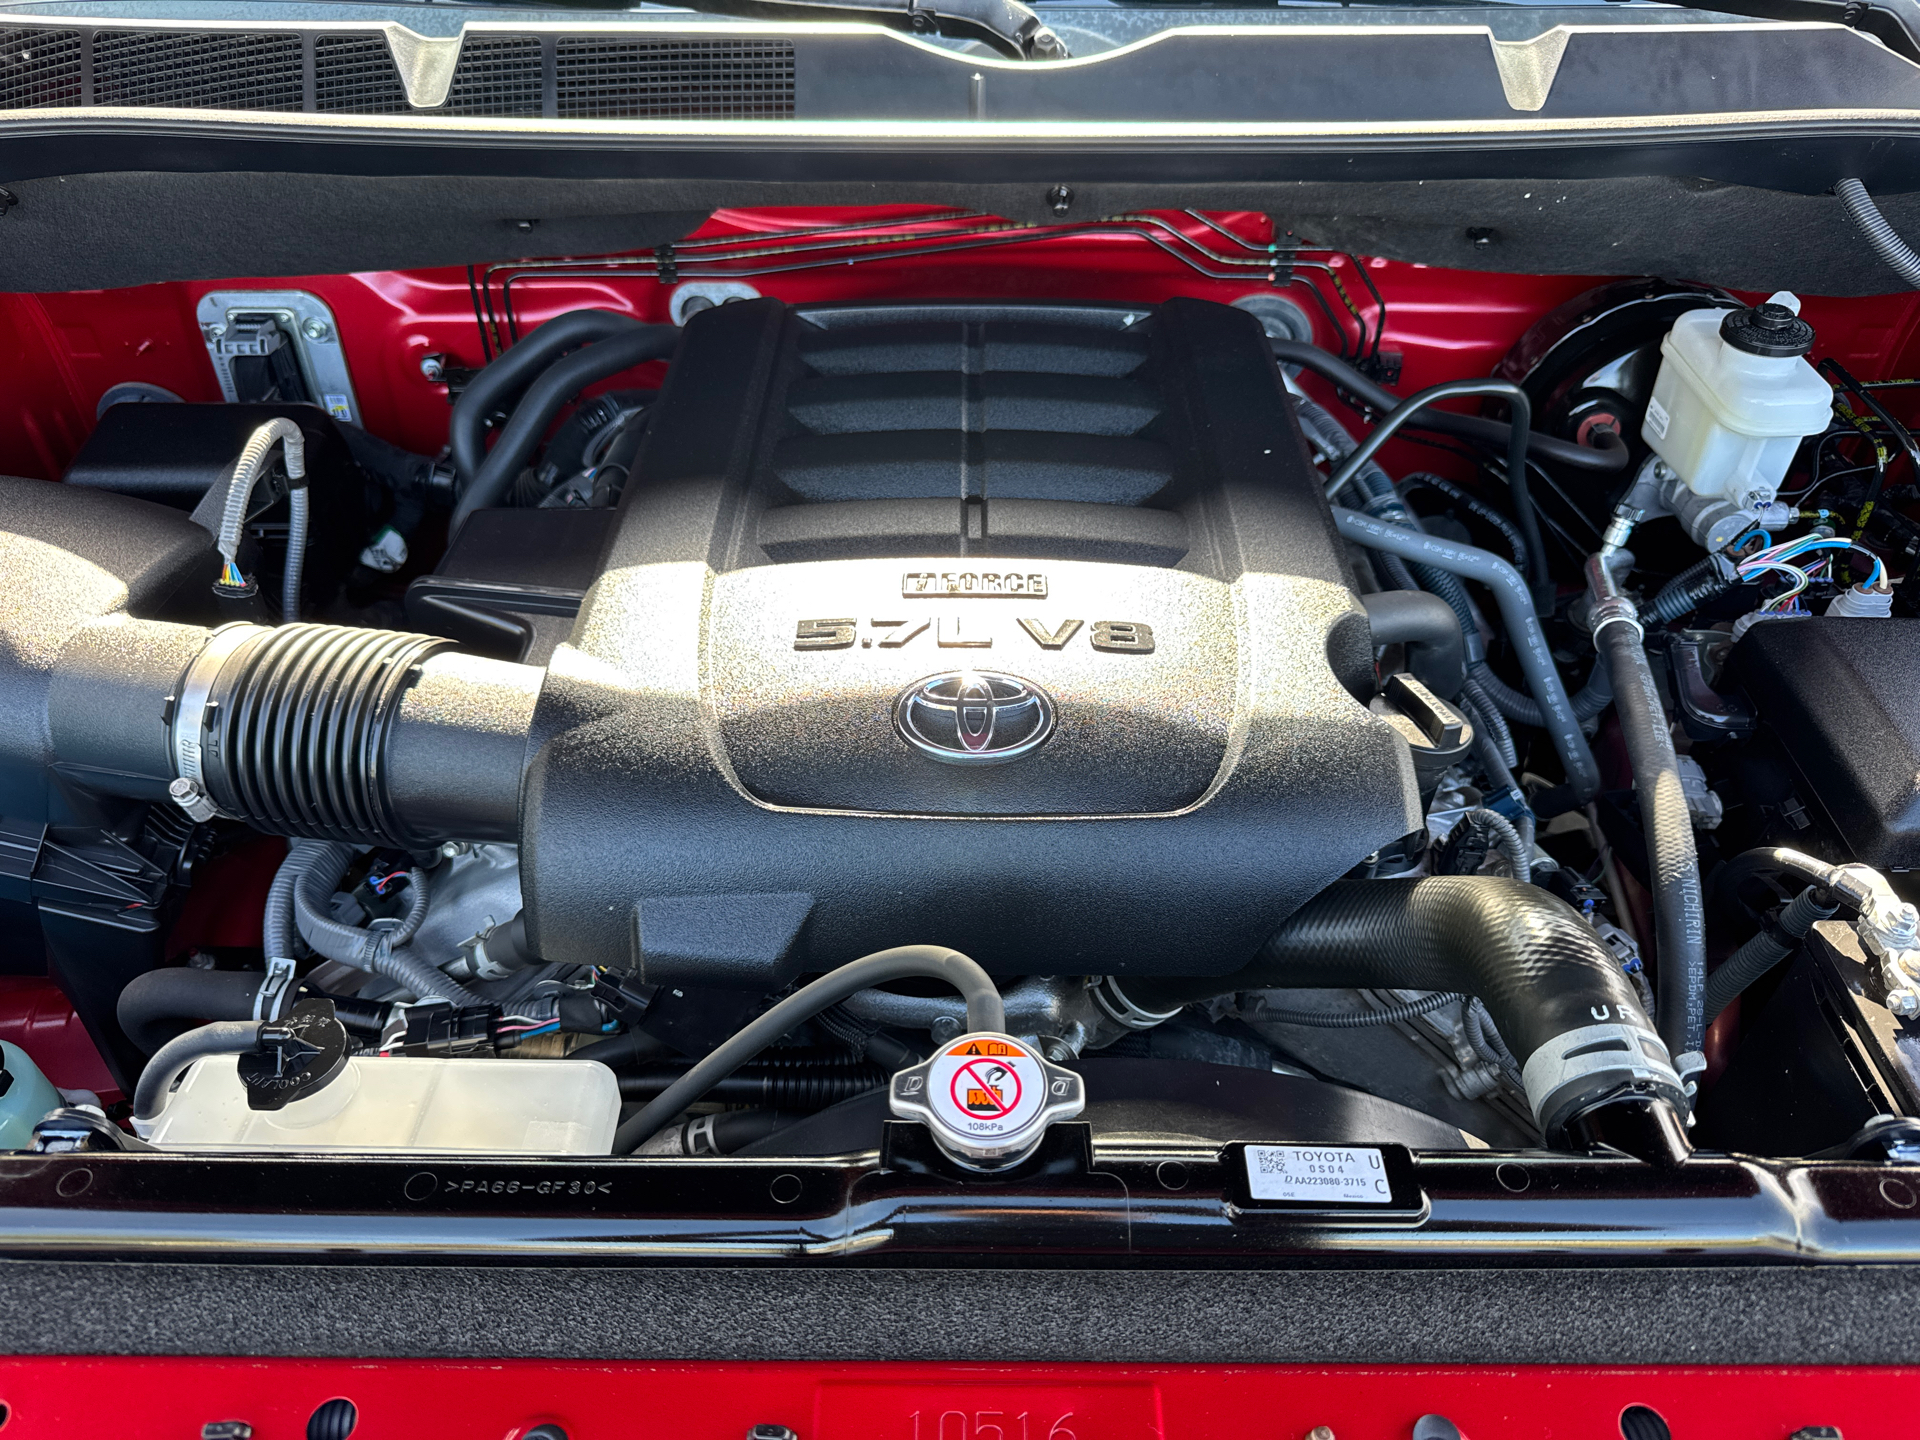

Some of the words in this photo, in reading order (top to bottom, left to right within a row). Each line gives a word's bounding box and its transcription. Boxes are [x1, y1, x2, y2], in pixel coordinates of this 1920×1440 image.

[941, 573, 1046, 593] FORCE
[794, 617, 993, 651] 5.7L
[1016, 617, 1155, 655] V8
[1681, 878, 1702, 945] NICHIRIN
[967, 1122, 1004, 1131] 108kPa
[1292, 1151, 1356, 1163] TOYOTA
[1368, 1154, 1381, 1170] U
[1374, 1179, 1387, 1194] C
[909, 1410, 1077, 1440] 10516
